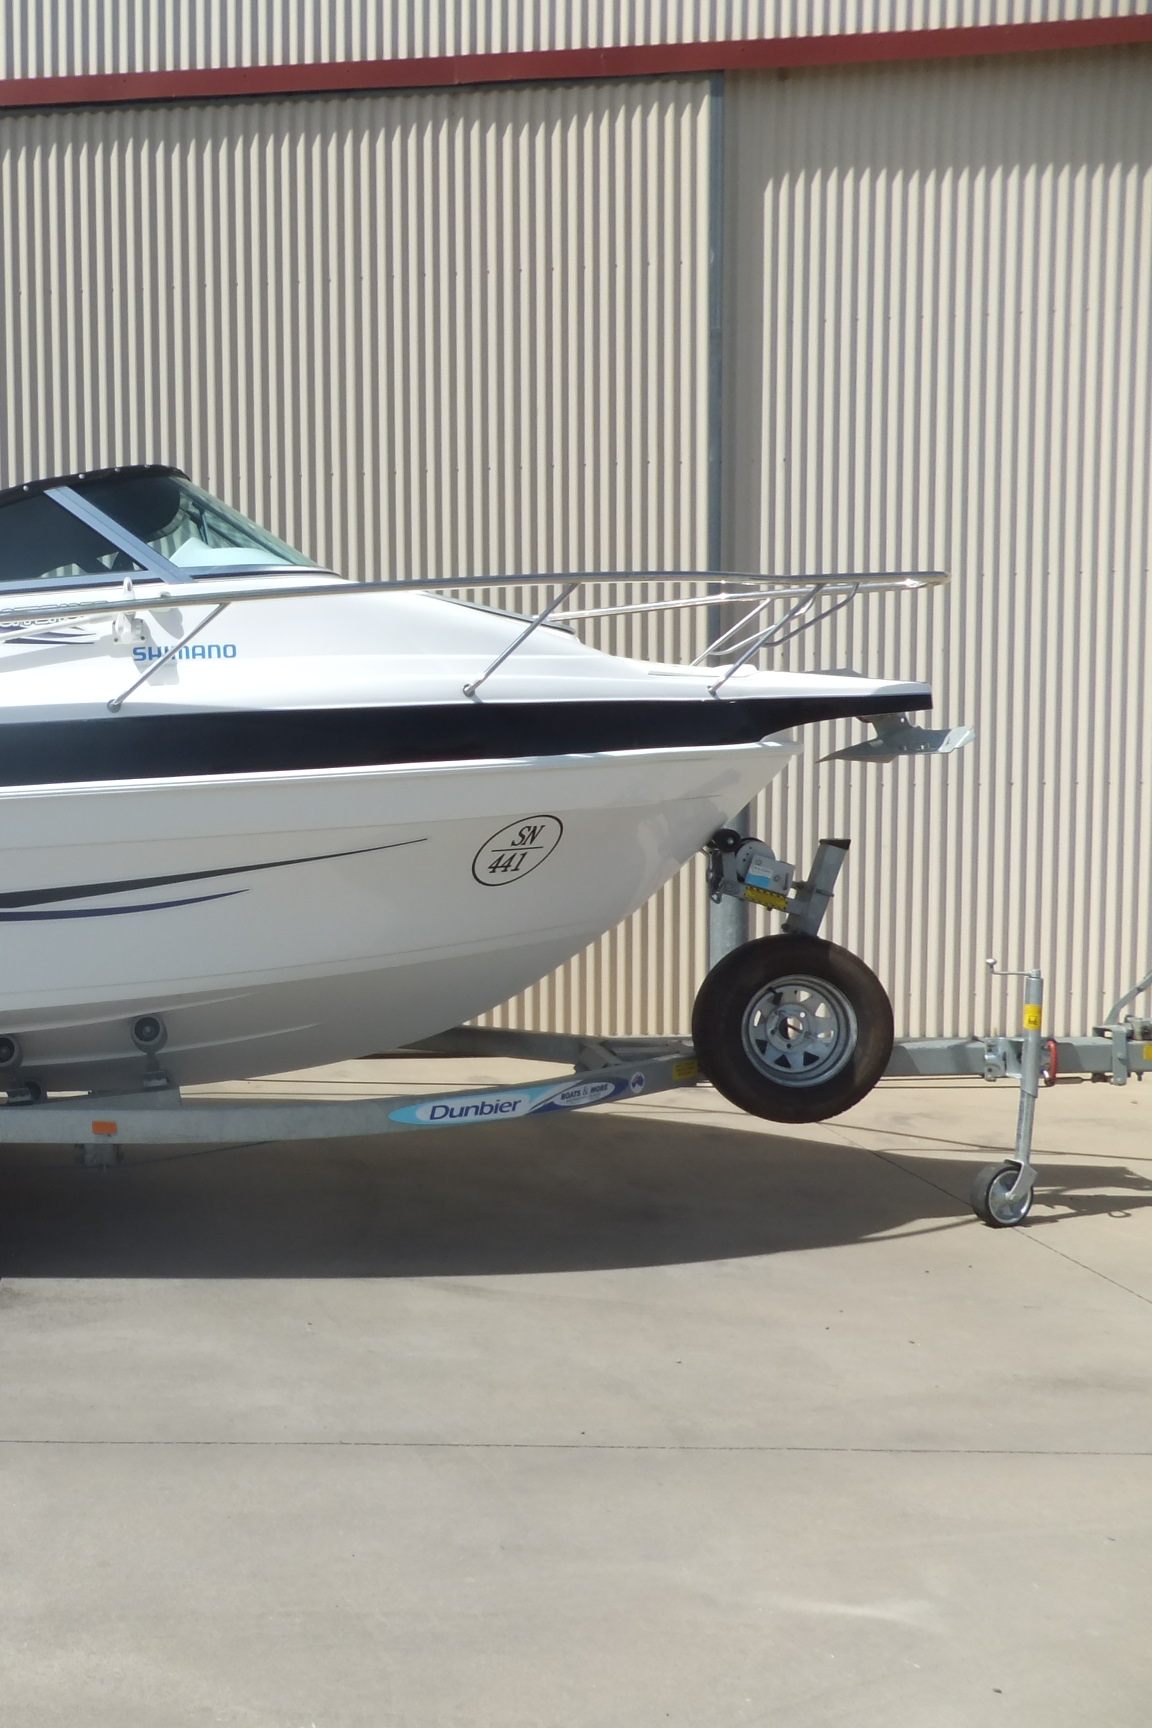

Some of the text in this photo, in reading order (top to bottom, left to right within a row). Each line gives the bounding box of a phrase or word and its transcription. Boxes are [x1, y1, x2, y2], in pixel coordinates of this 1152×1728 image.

[510, 825, 546, 846] SN
[487, 852, 528, 873] 441
[429, 1099, 522, 1120] Dunbier
